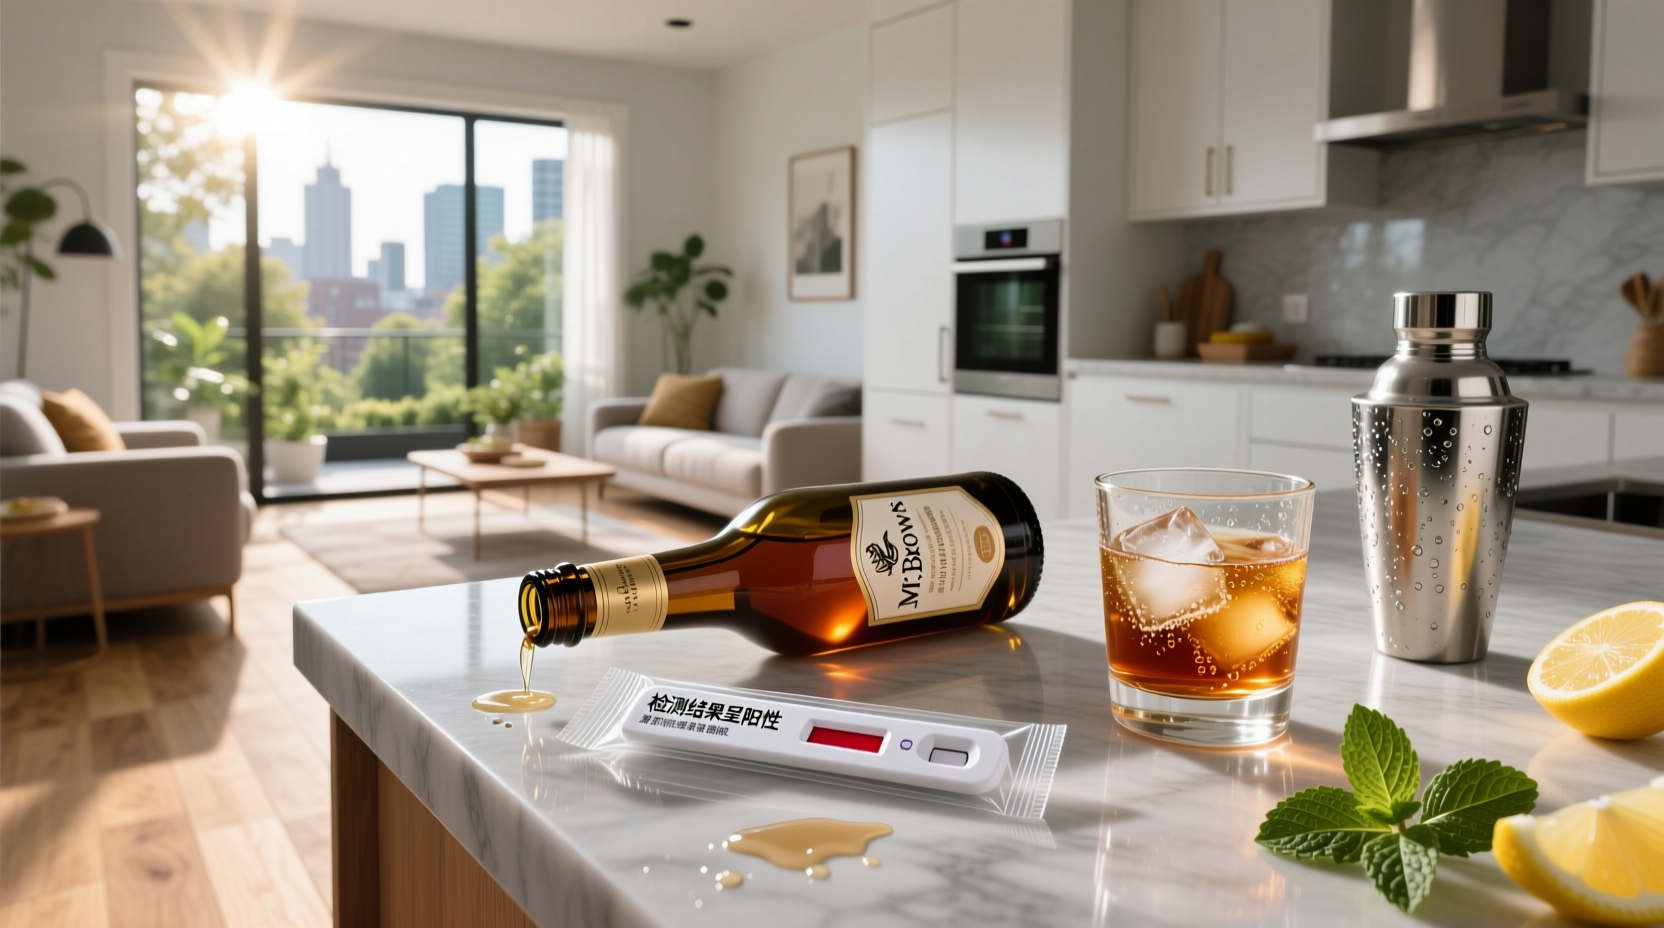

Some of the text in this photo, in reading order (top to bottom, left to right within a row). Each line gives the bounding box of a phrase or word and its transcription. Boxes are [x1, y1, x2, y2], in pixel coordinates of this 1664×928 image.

[647, 692, 783, 731] 检测结果呈阳性
